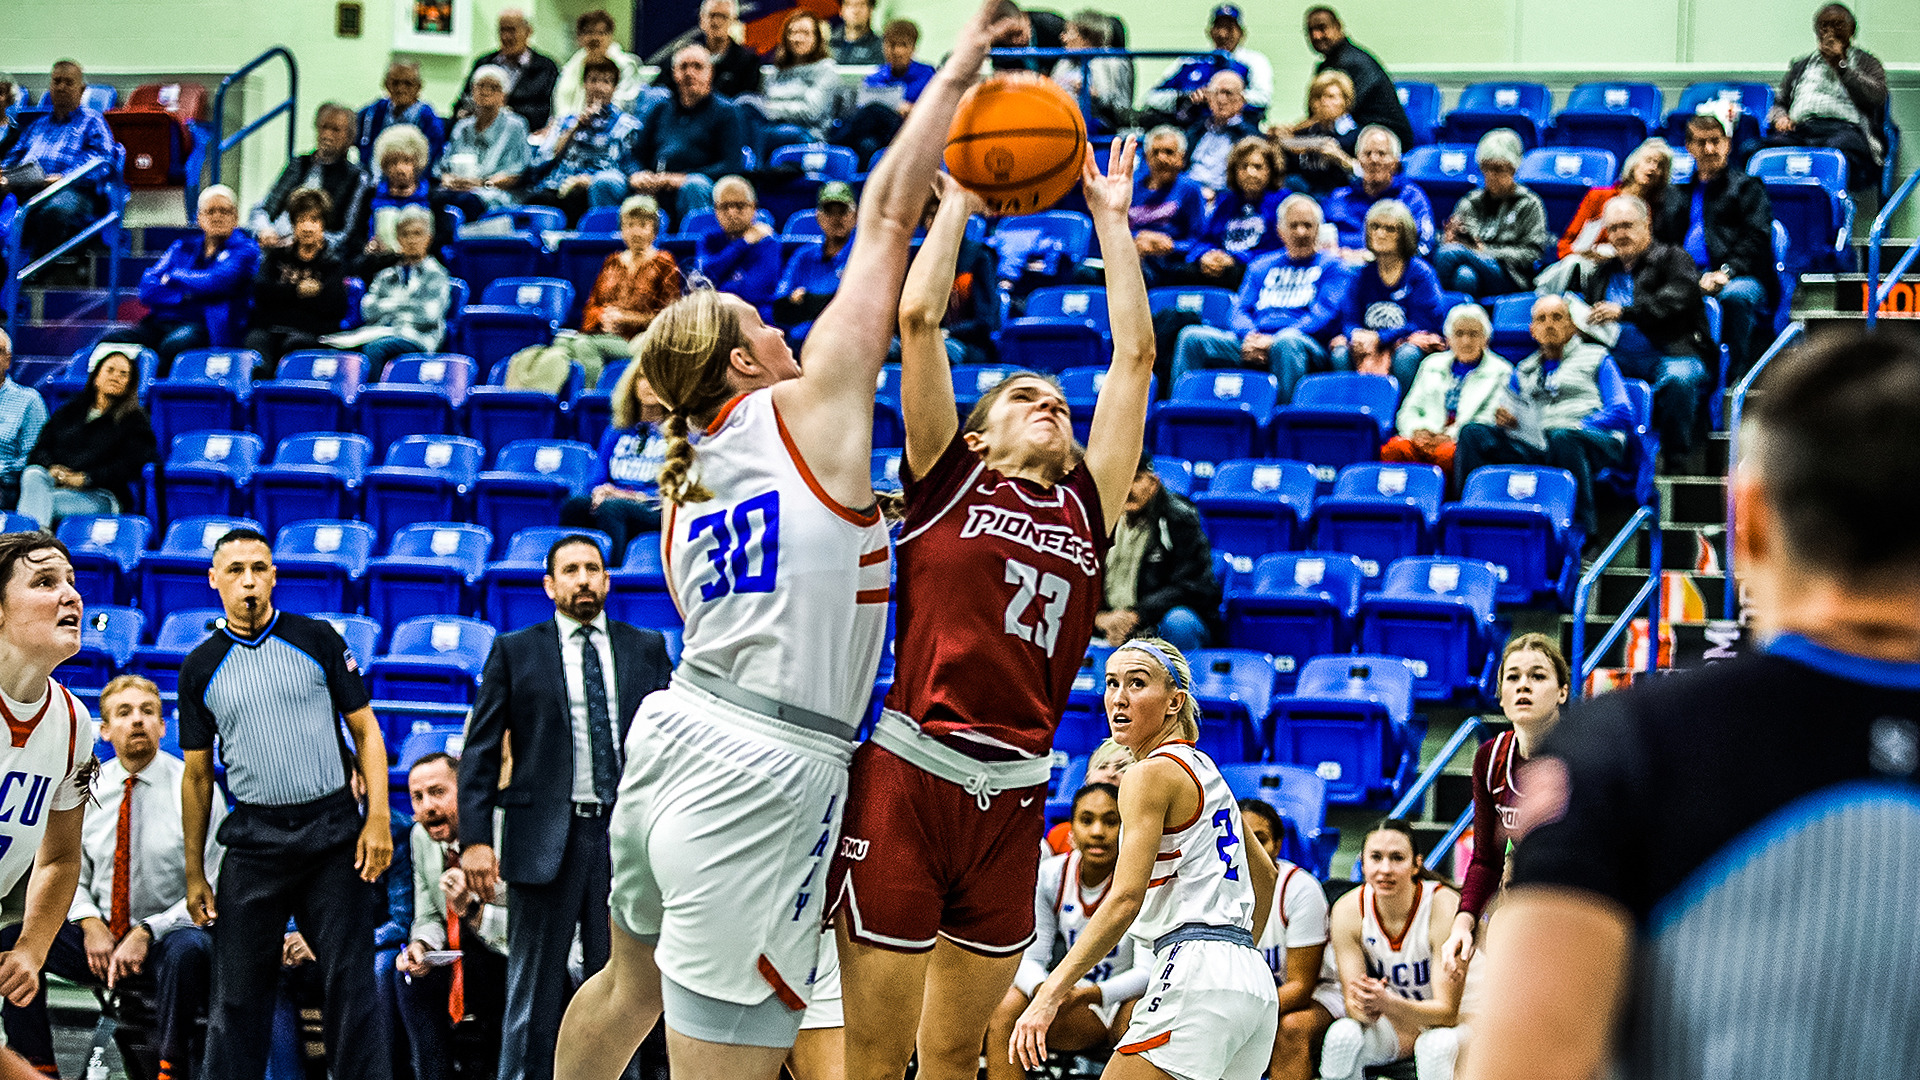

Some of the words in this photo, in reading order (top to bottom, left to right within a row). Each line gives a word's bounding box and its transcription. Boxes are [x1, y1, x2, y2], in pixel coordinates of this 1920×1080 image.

[688, 490, 779, 603] 30
[1005, 558, 1071, 658] 23
[1211, 807, 1240, 882] 2
